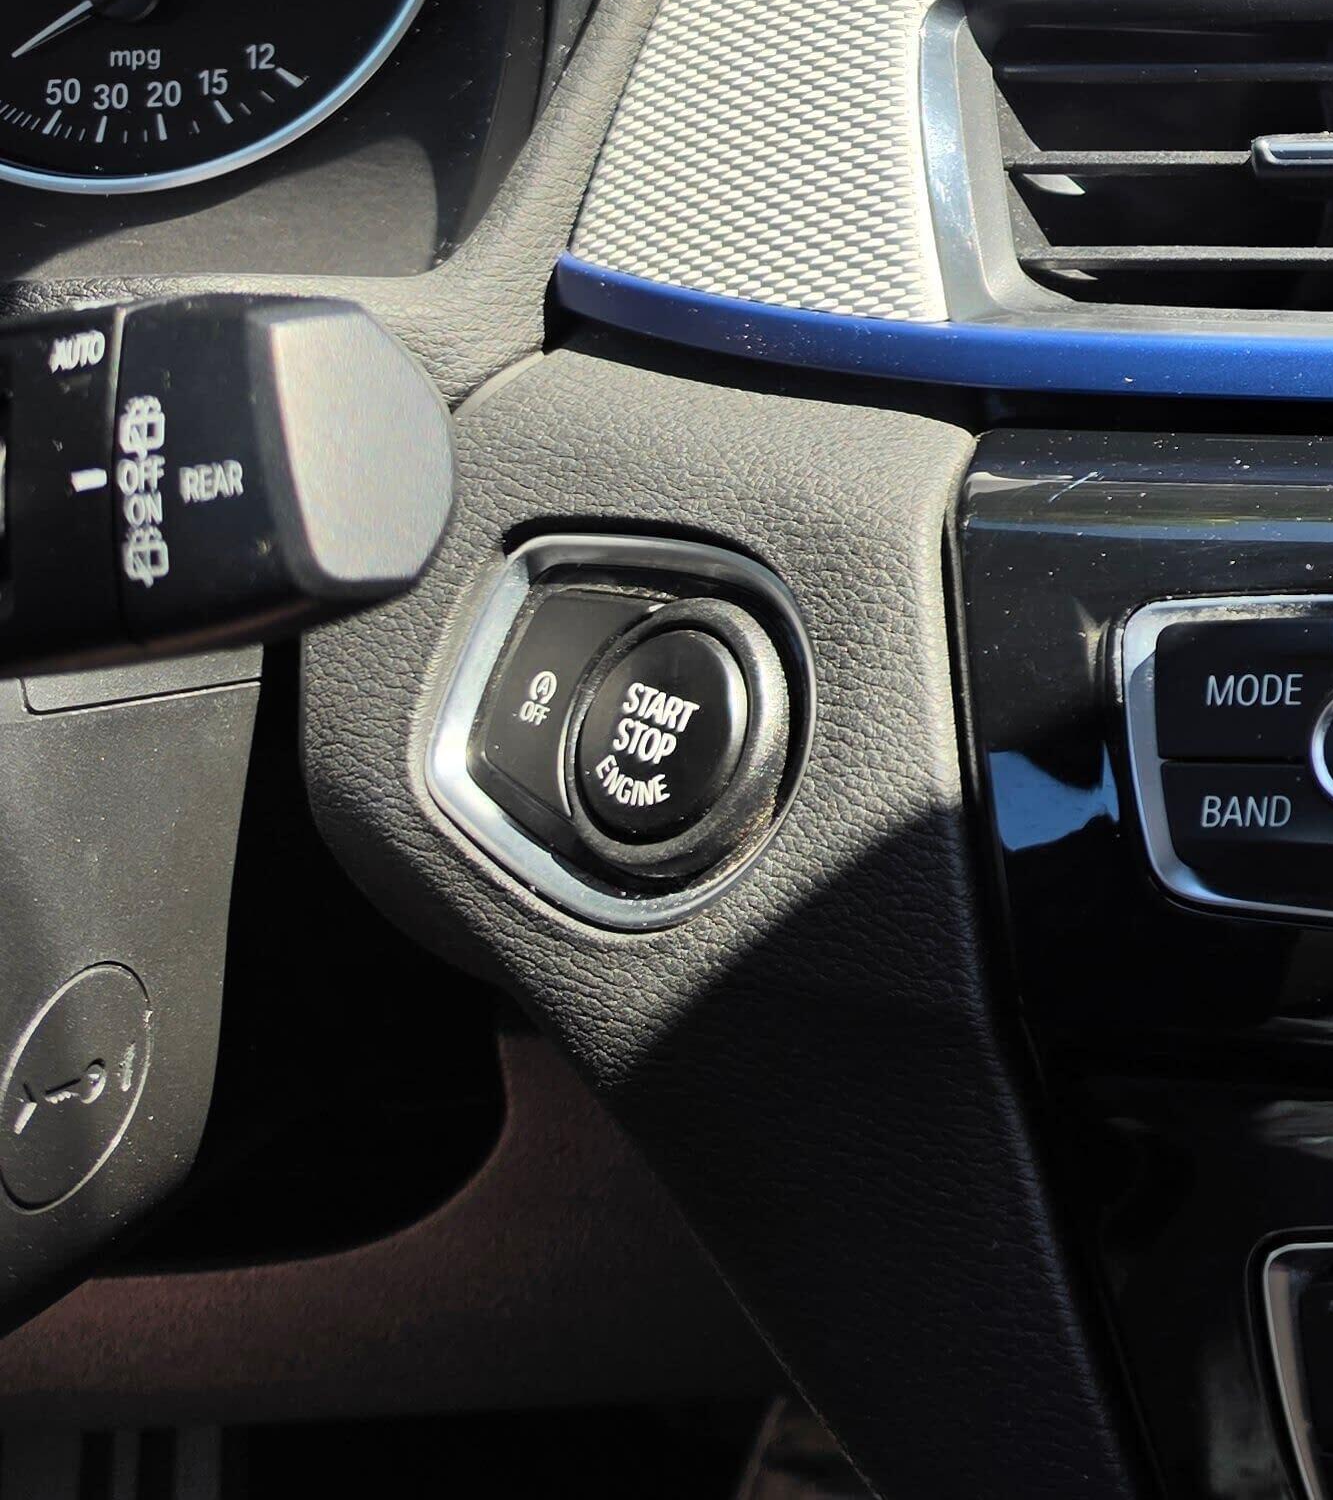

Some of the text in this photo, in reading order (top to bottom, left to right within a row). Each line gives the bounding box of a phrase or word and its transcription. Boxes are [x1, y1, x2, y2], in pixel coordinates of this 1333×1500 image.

[45, 43, 276, 110] 50 30 20 15 12
[109, 45, 162, 71] mpg
[48, 329, 106, 374] AUTO
[116, 454, 166, 496] OFF
[178, 459, 244, 504] REAR
[123, 491, 163, 527] ON
[622, 682, 701, 733] START
[1204, 672, 1304, 708] MODE
[518, 700, 551, 726] OFF
[612, 717, 677, 764] STOP
[595, 754, 671, 807] ENGINE
[1200, 794, 1292, 829] BAND
